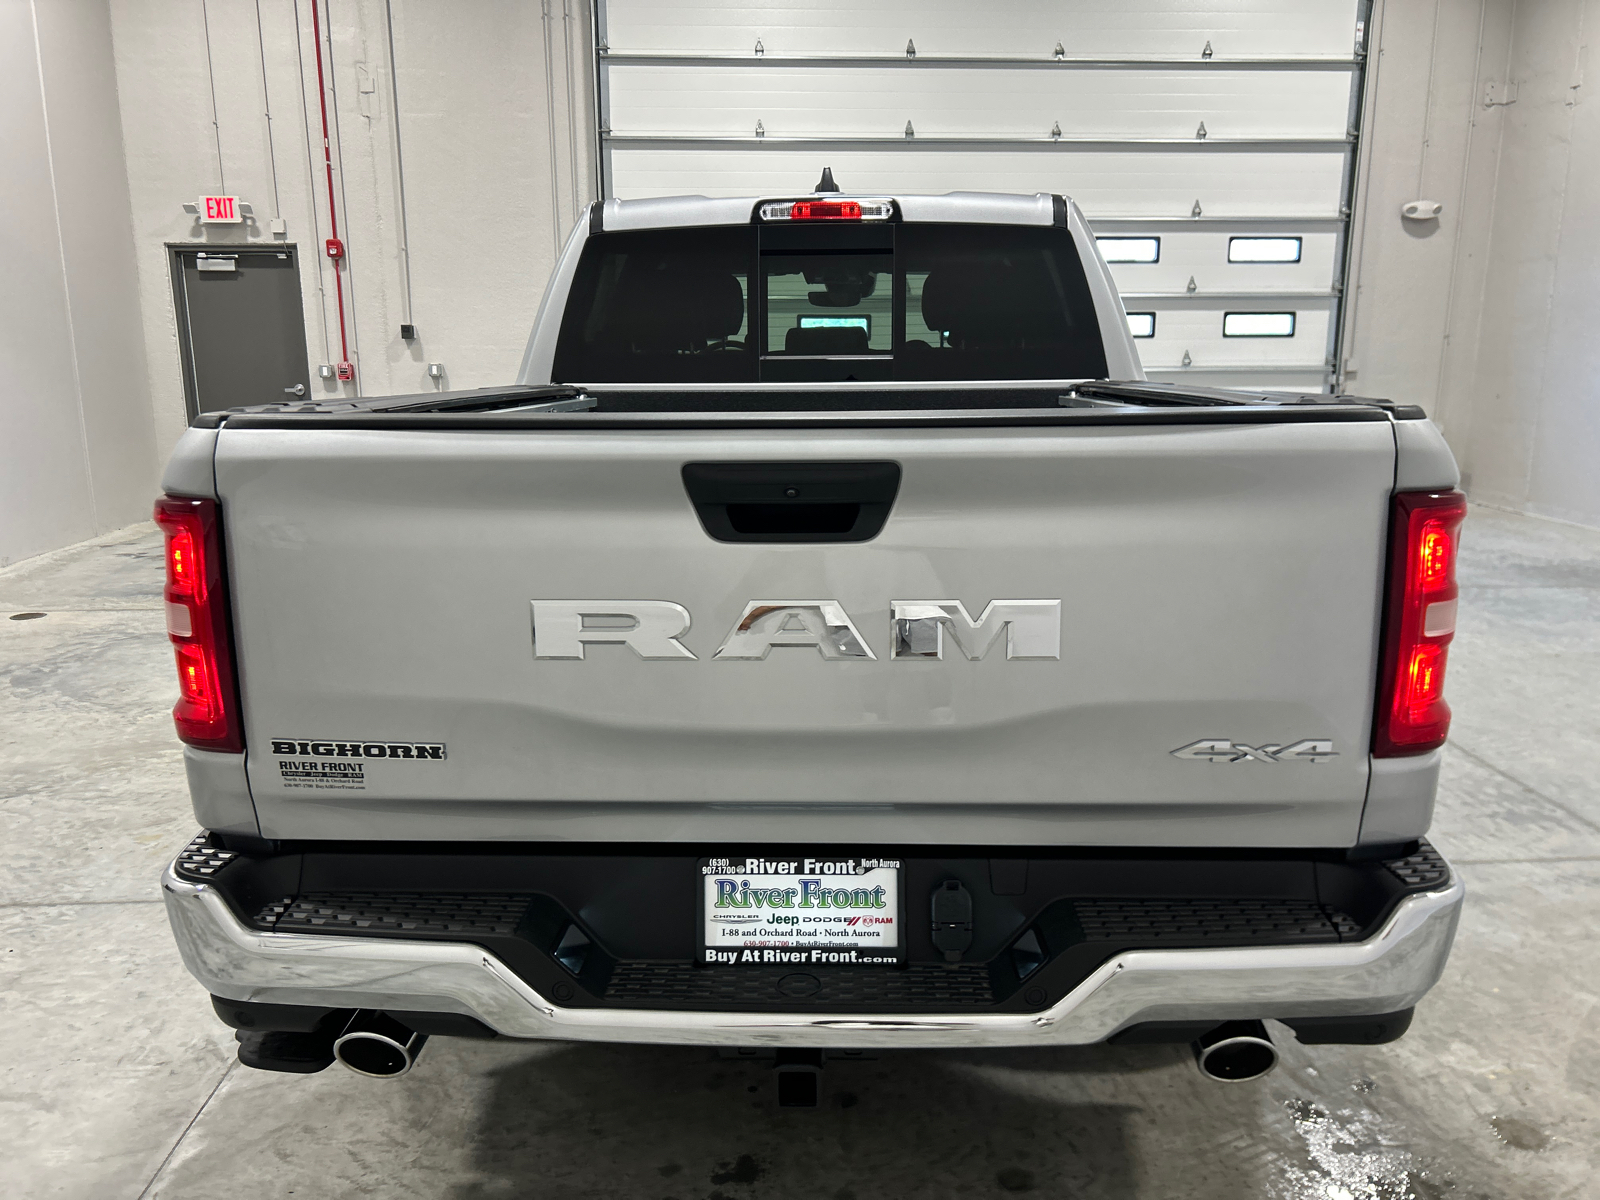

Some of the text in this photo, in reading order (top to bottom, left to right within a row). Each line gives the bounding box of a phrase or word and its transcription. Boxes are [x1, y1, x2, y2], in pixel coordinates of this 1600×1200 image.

[205, 197, 234, 219] EXIT
[530, 598, 1061, 661] RAM
[271, 739, 446, 760] BIGHORN
[1169, 738, 1340, 763] 4x4
[279, 761, 364, 772] RIVER FRONT
[709, 858, 729, 867] (630)
[745, 858, 855, 875] River Front
[861, 858, 900, 868] North Aurora
[702, 866, 736, 875] 907-1700
[714, 878, 886, 909] River Front
[766, 913, 799, 926] Jeep
[722, 928, 880, 937] I-88 and Orchard Road North Aurora
[705, 950, 738, 964] Buy
[741, 950, 760, 963] At
[764, 950, 808, 963] River
